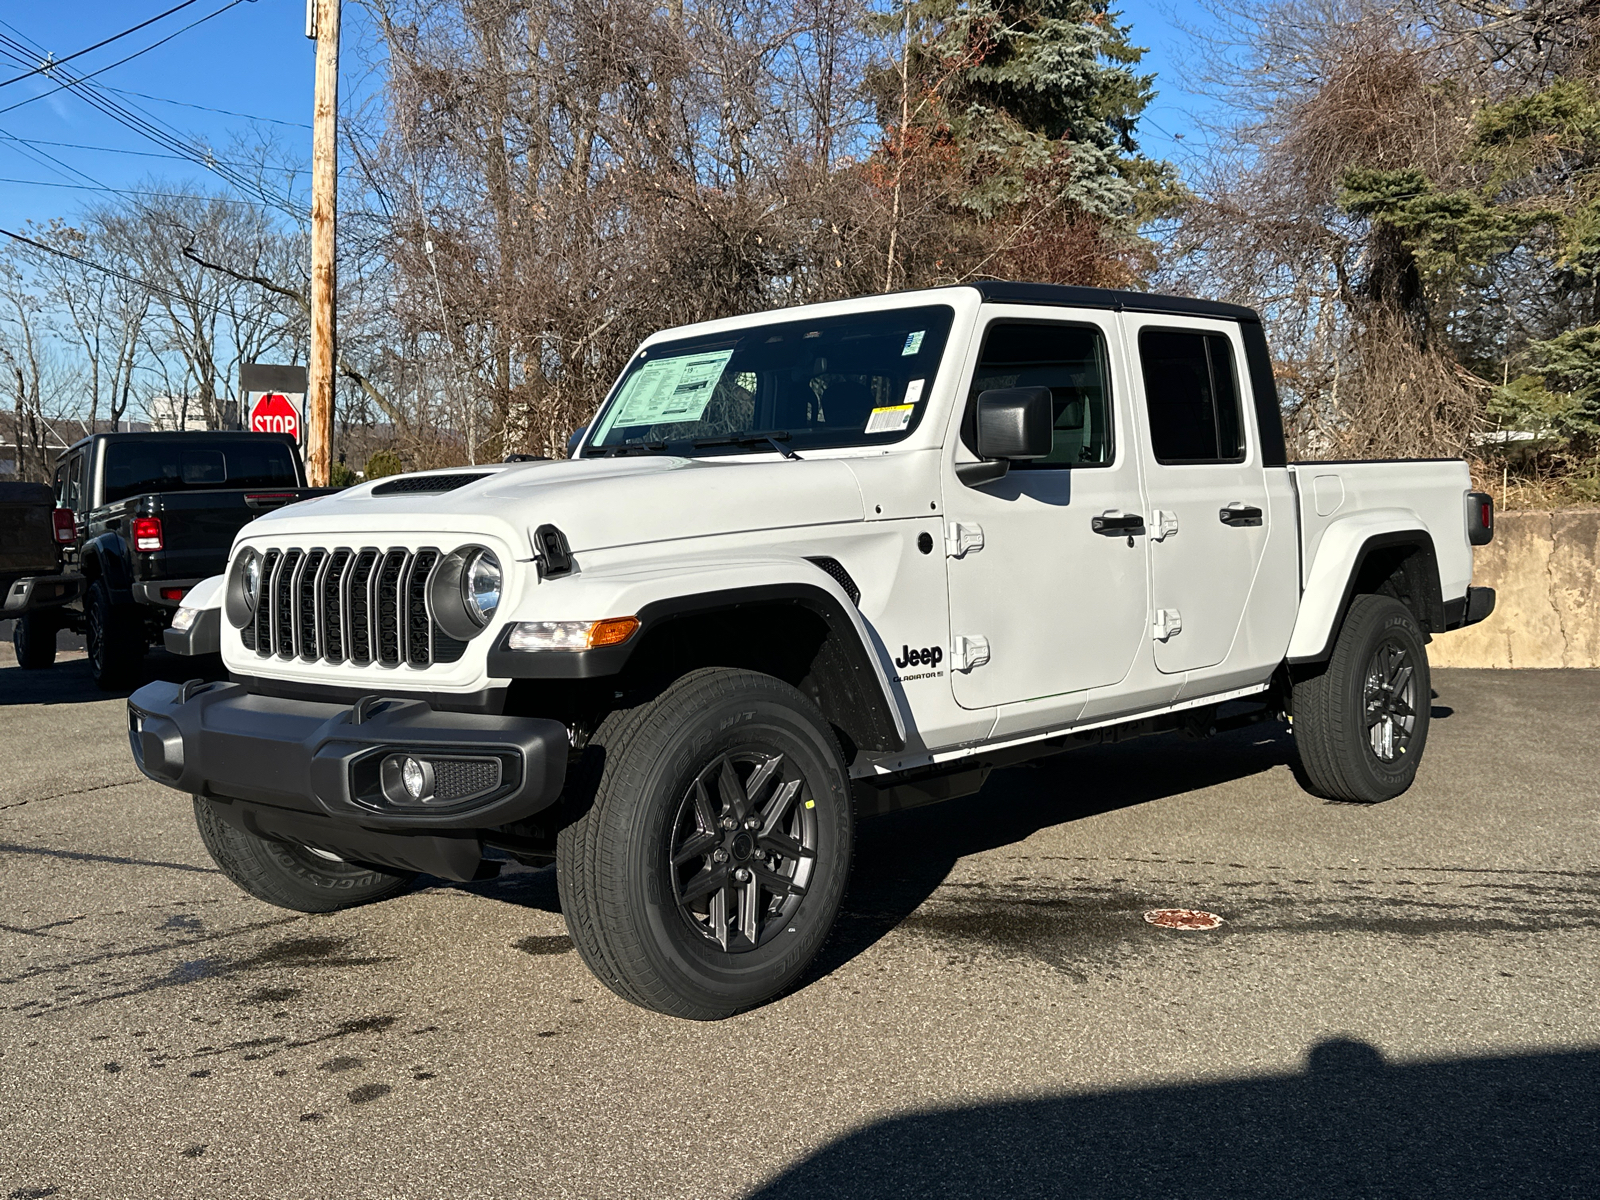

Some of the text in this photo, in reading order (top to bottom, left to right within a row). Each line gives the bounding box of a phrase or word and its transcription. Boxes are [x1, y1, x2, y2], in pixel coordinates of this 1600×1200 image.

[254, 415, 295, 433] STOP
[895, 644, 943, 669] Jeep
[892, 672, 936, 683] GLADIATOR
